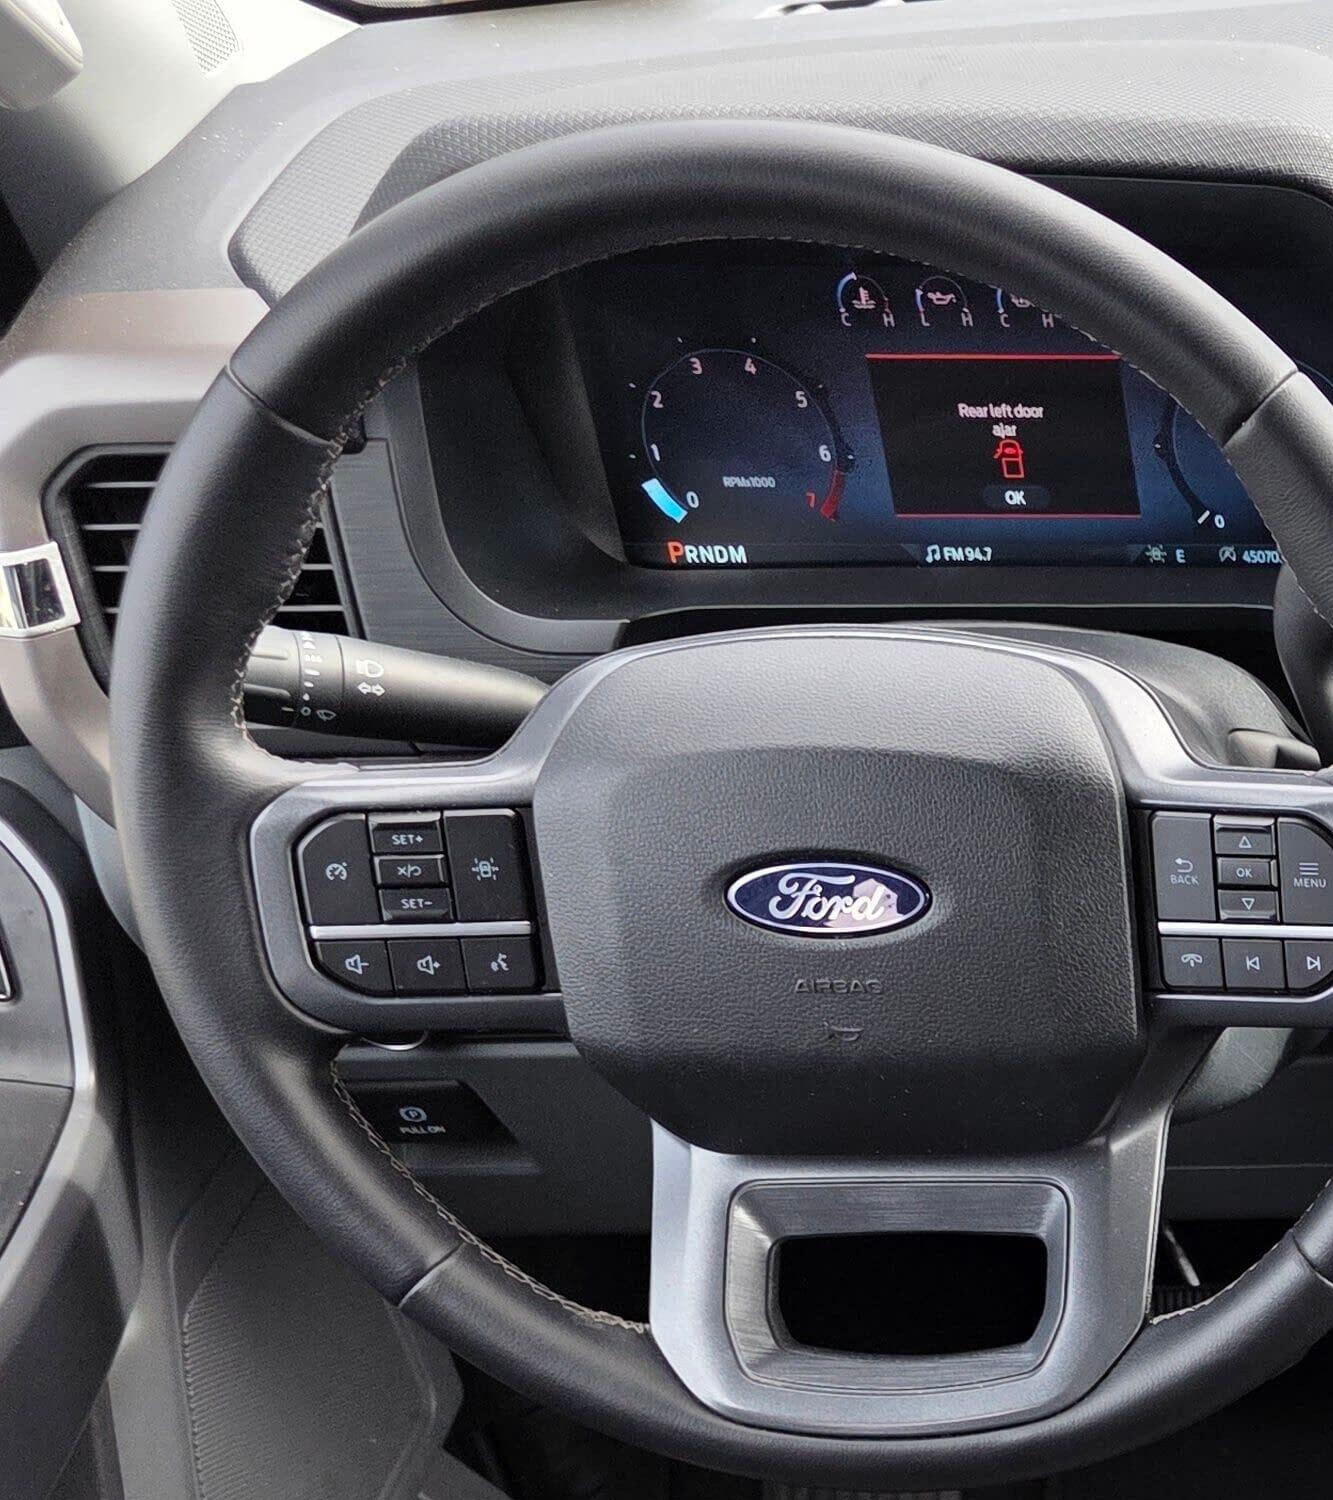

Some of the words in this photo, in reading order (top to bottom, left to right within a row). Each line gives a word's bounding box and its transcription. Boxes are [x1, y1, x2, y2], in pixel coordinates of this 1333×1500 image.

[691, 358, 702, 375] 3
[745, 359, 757, 374] 4
[651, 391, 663, 408] 2
[795, 391, 808, 408] 5
[958, 403, 988, 418] Rear
[990, 404, 1012, 418] left
[1015, 404, 1043, 418] door
[992, 423, 1017, 438] ajar
[819, 445, 832, 461] 6
[686, 491, 699, 508] 0
[1004, 491, 1026, 505] OK
[943, 547, 964, 561] FM
[965, 547, 992, 562] 94.7
[1176, 549, 1186, 563] E
[1171, 874, 1199, 885] BACK
[1237, 867, 1253, 878] OK
[1294, 878, 1326, 888] MENU
[768, 872, 884, 921] Ford
[794, 980, 882, 994] AIRBAG
